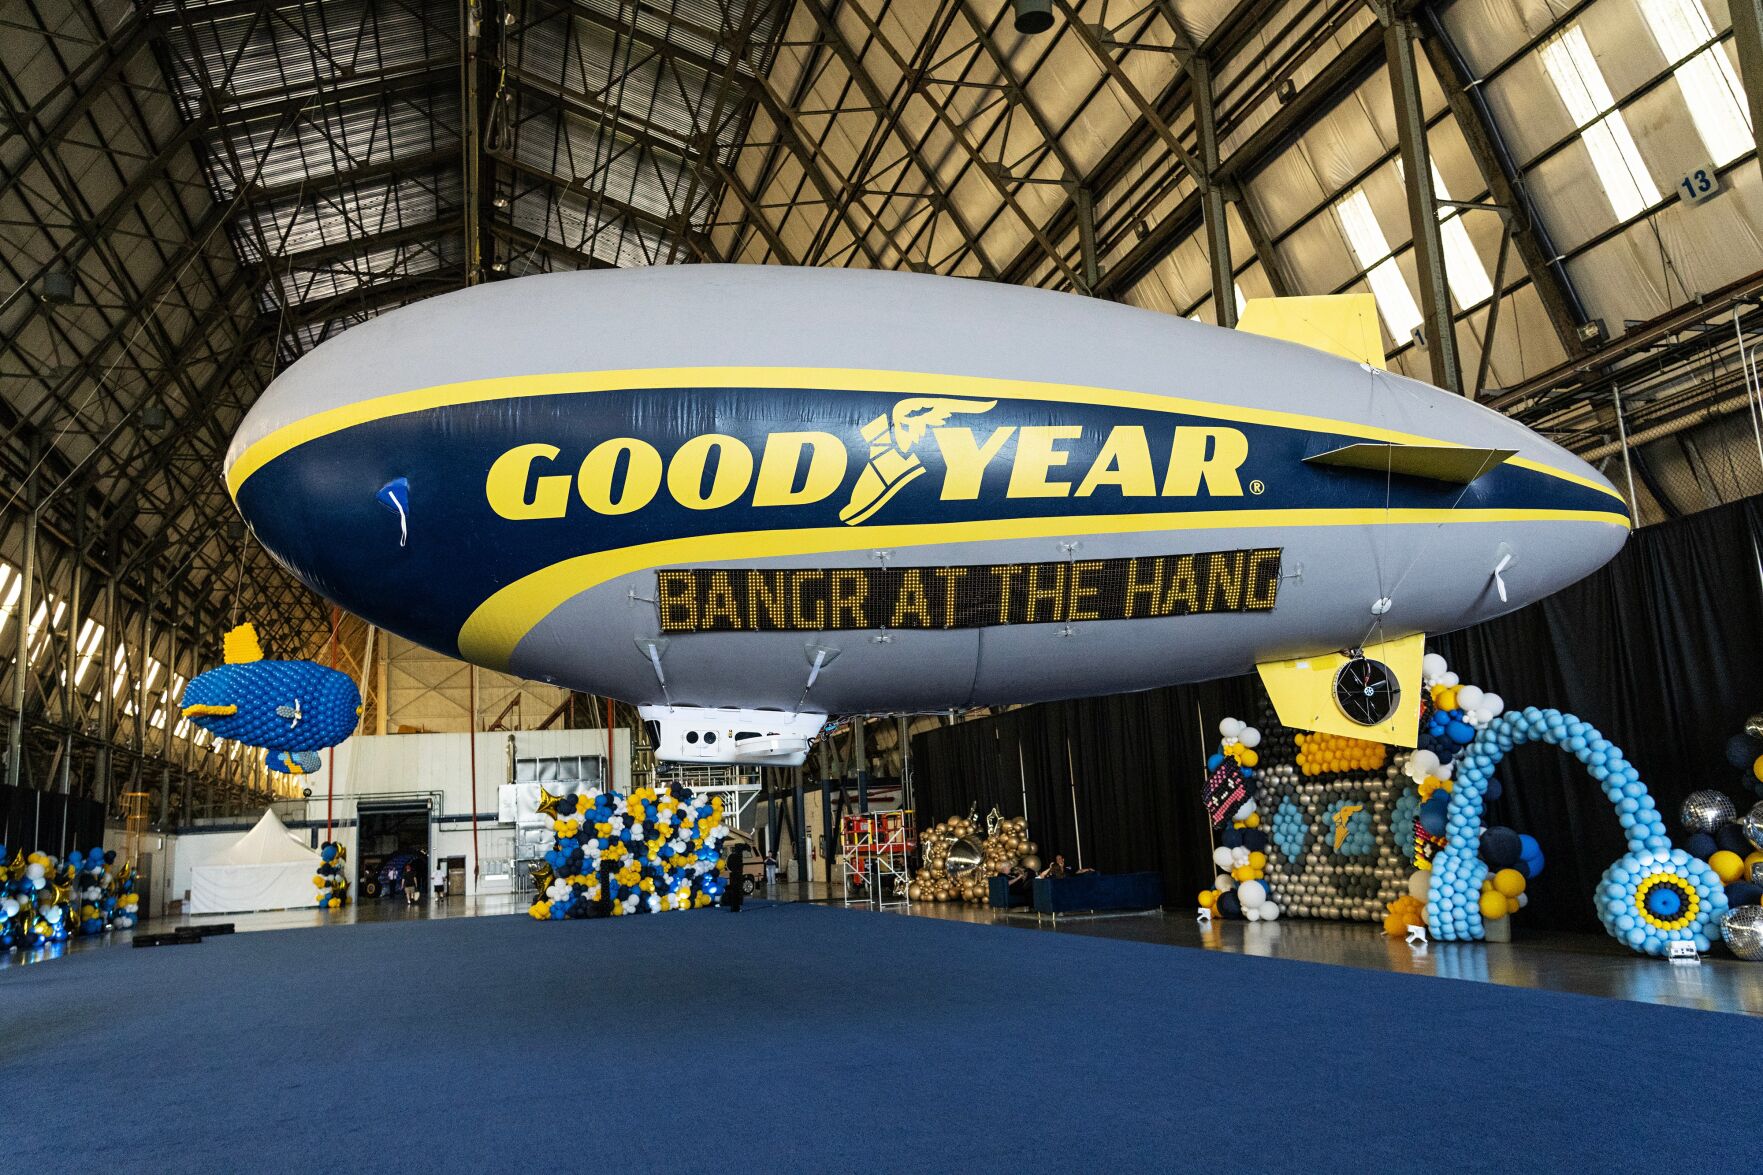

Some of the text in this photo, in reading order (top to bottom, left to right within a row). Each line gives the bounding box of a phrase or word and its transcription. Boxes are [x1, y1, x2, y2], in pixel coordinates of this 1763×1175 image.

[1681, 169, 1711, 198] 13
[891, 568, 967, 627] AT
[991, 561, 1104, 623] THE
[1124, 549, 1280, 618] HANG
